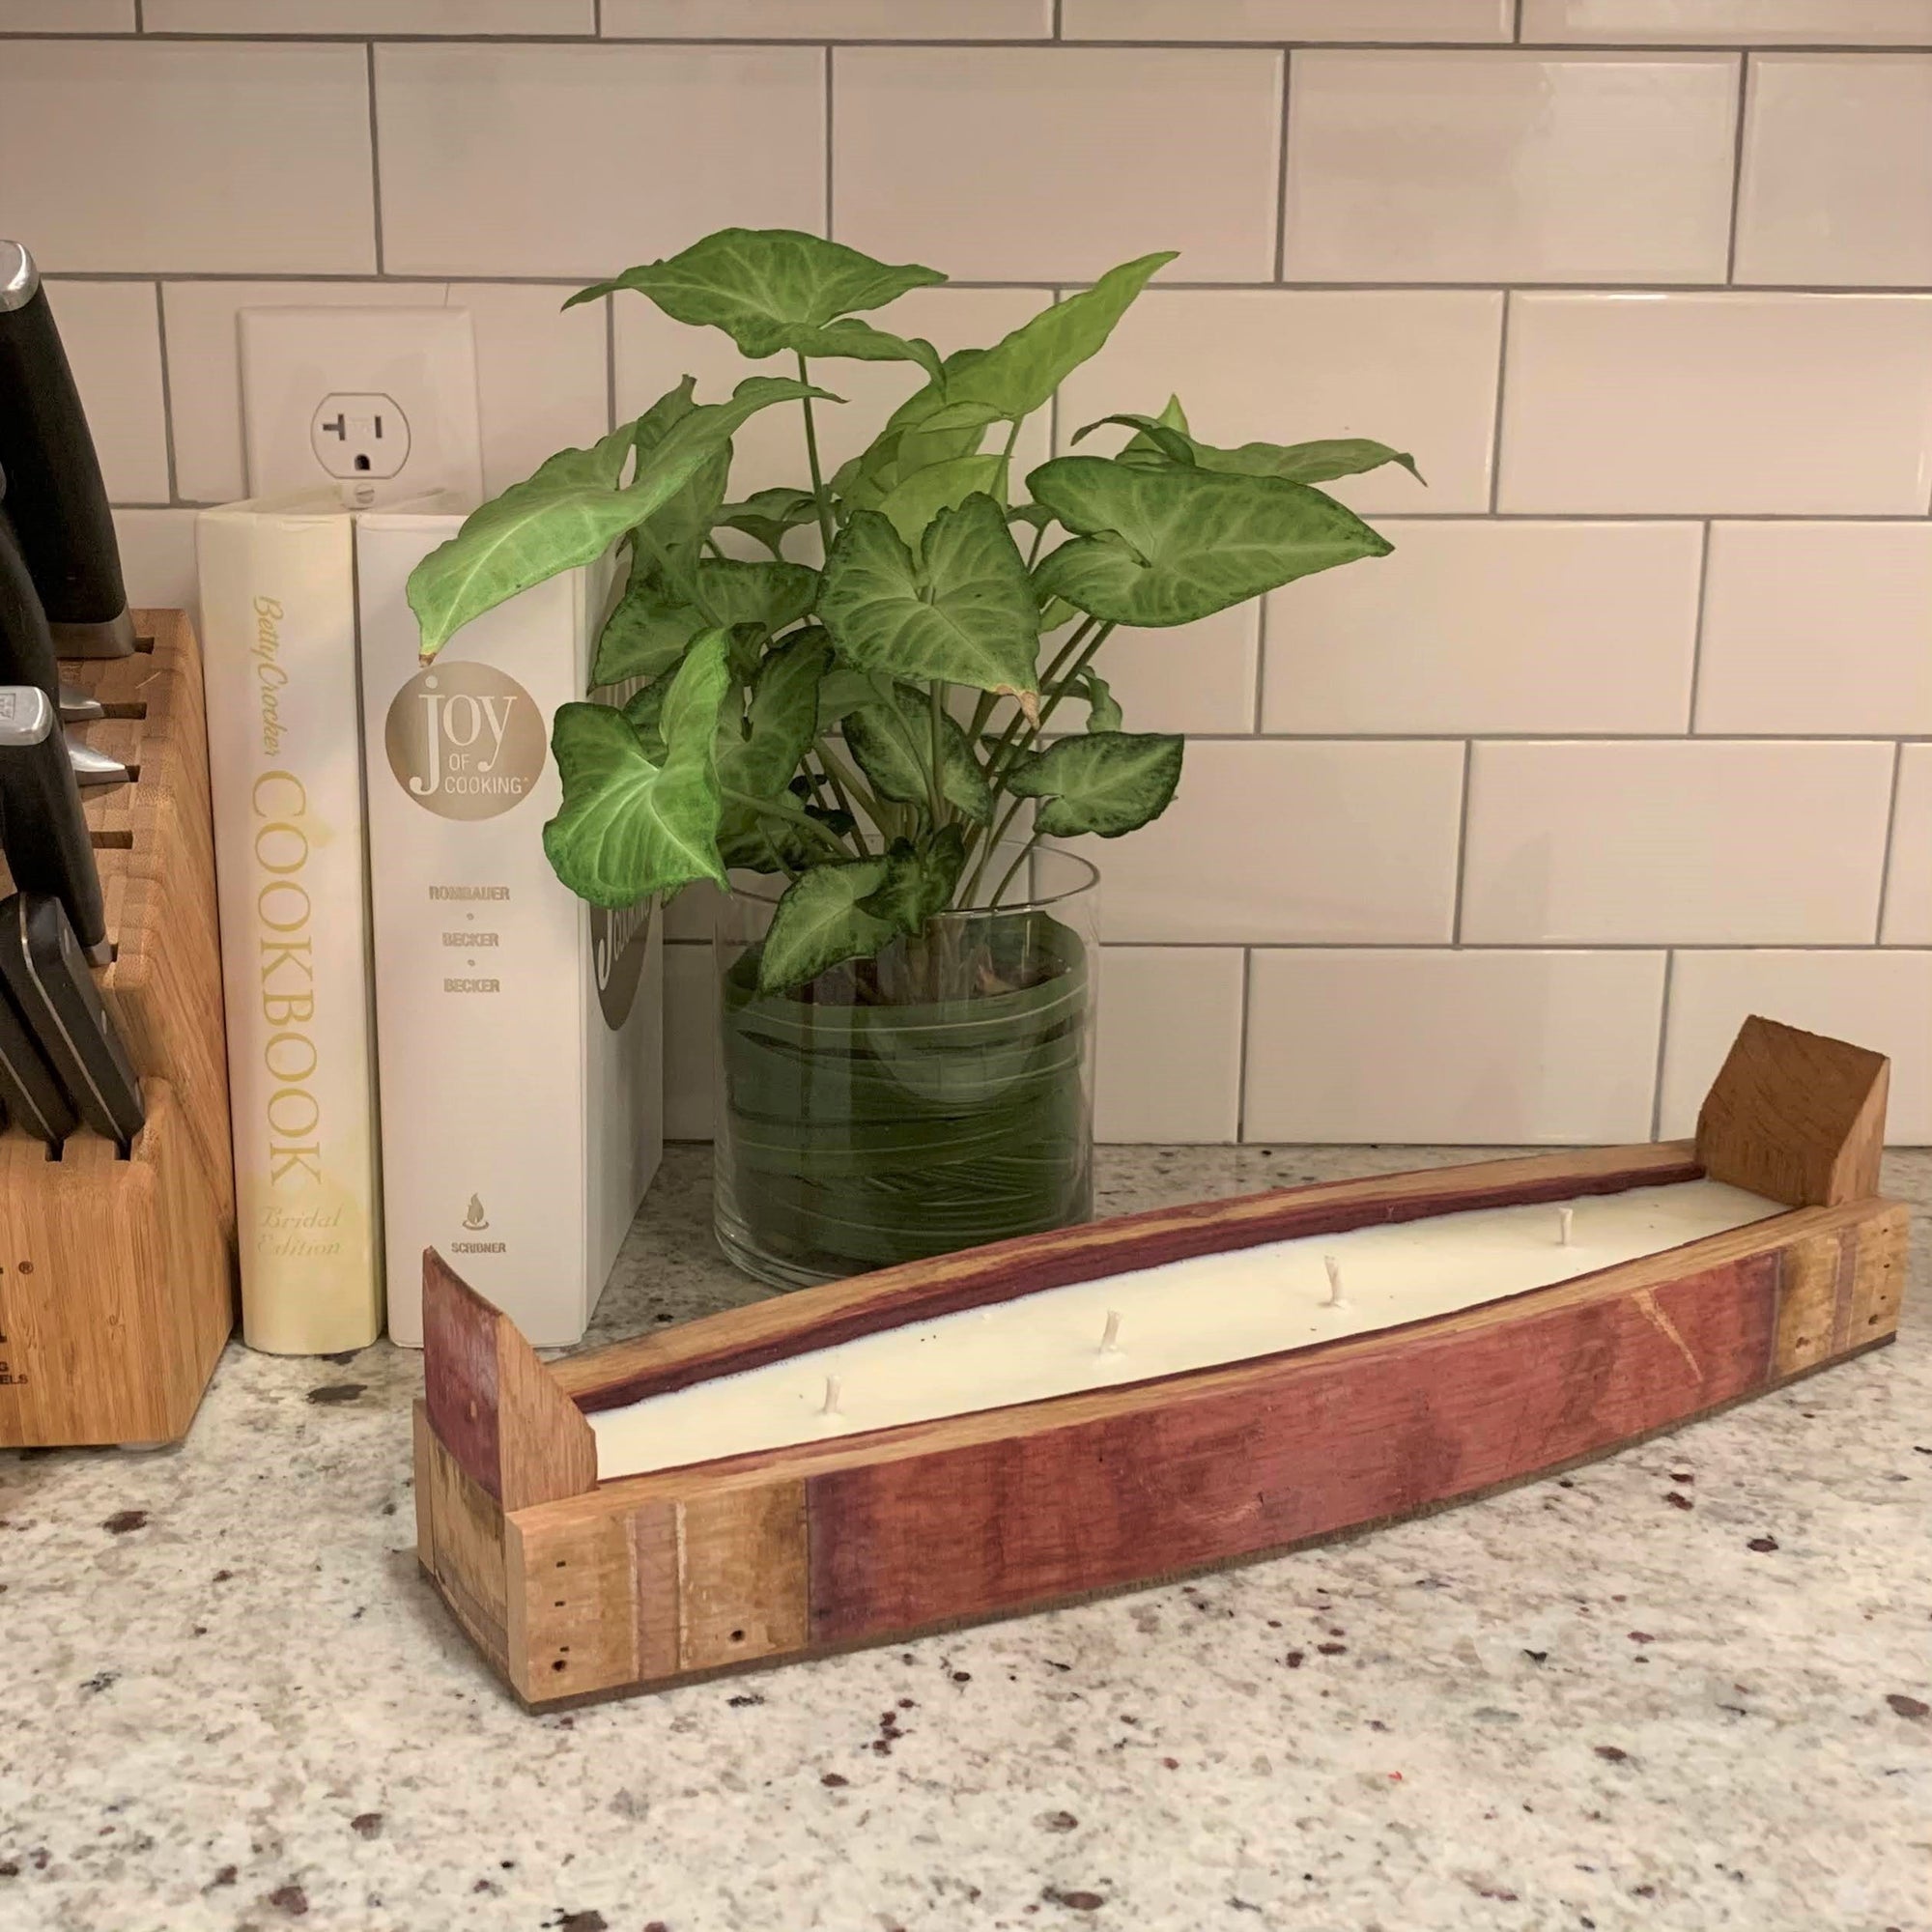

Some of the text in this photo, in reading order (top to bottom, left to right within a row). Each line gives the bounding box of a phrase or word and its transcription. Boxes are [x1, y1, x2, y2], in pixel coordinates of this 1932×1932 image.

[449, 753, 470, 771] OF
[444, 776, 523, 795] COOKING
[250, 594, 322, 1187] Betty Crocker COOKBOOK
[442, 932, 499, 947] BECKER
[443, 979, 500, 993] BECKER
[262, 1203, 345, 1229] Bridal
